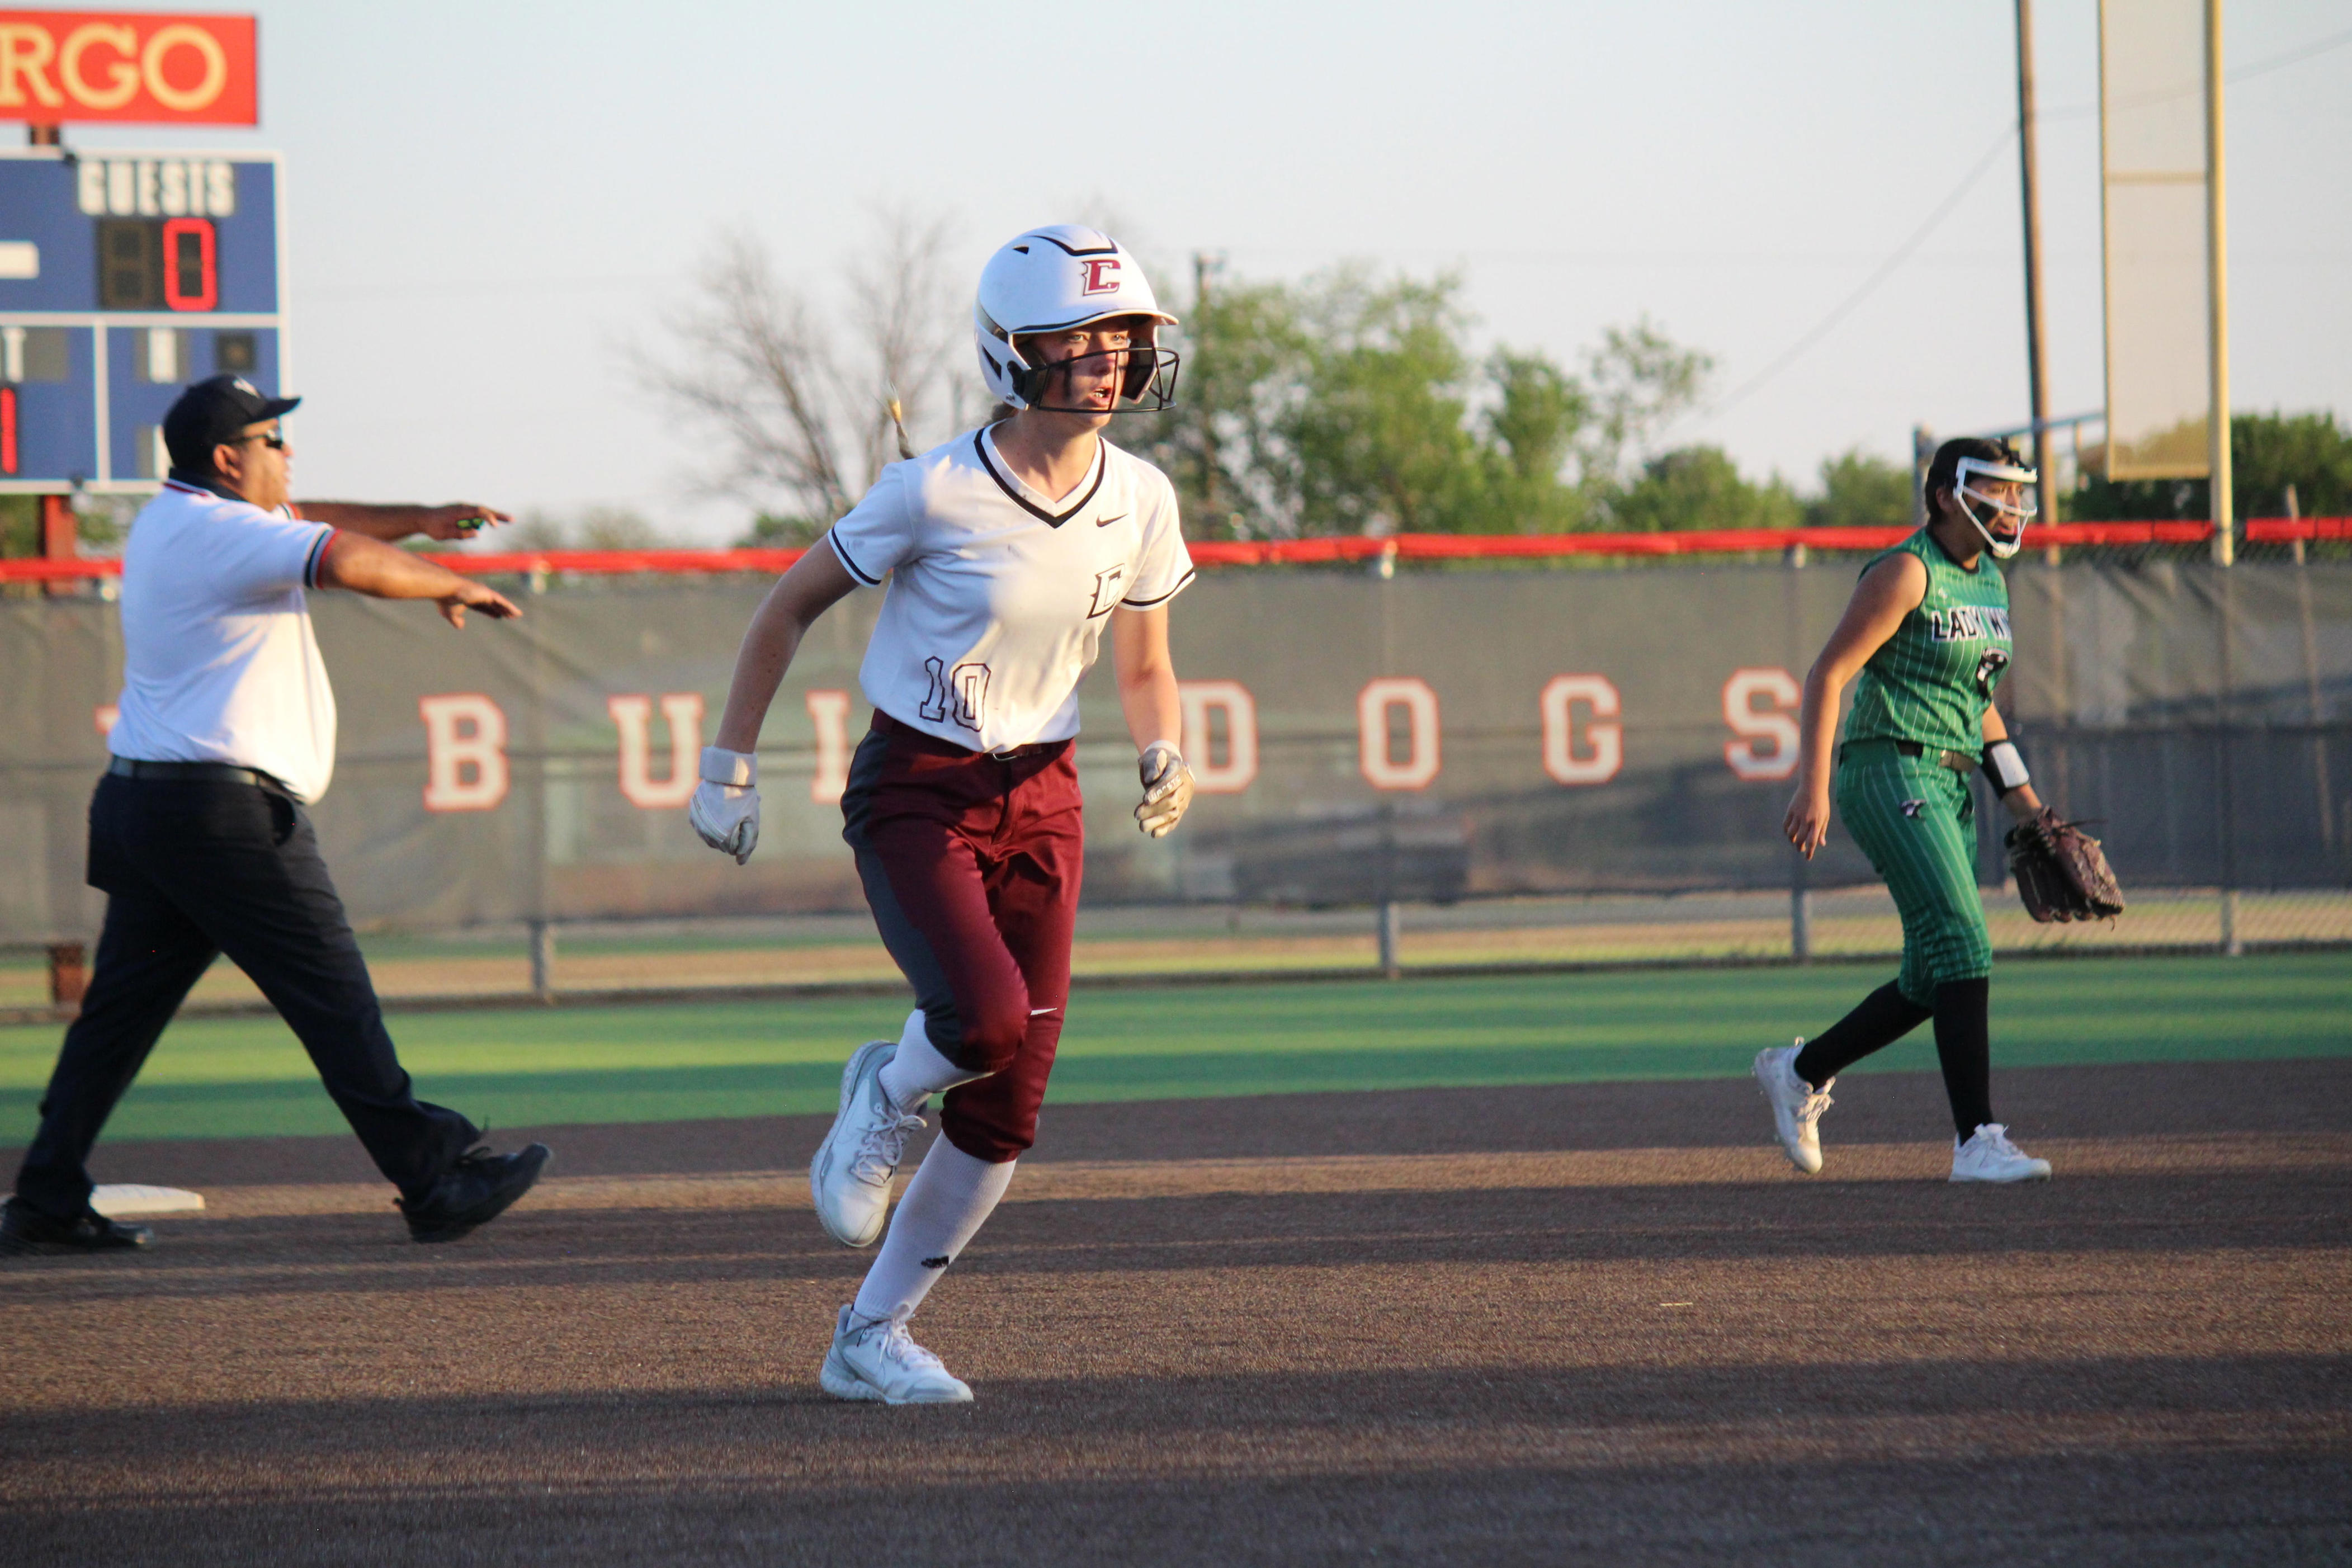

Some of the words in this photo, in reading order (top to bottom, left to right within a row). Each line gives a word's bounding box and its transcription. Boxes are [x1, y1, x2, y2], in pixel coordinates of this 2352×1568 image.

[78, 160, 235, 217] GUESTS
[163, 217, 218, 311] 0
[919, 655, 992, 733] 10
[419, 665, 1802, 813] BULDOGS
